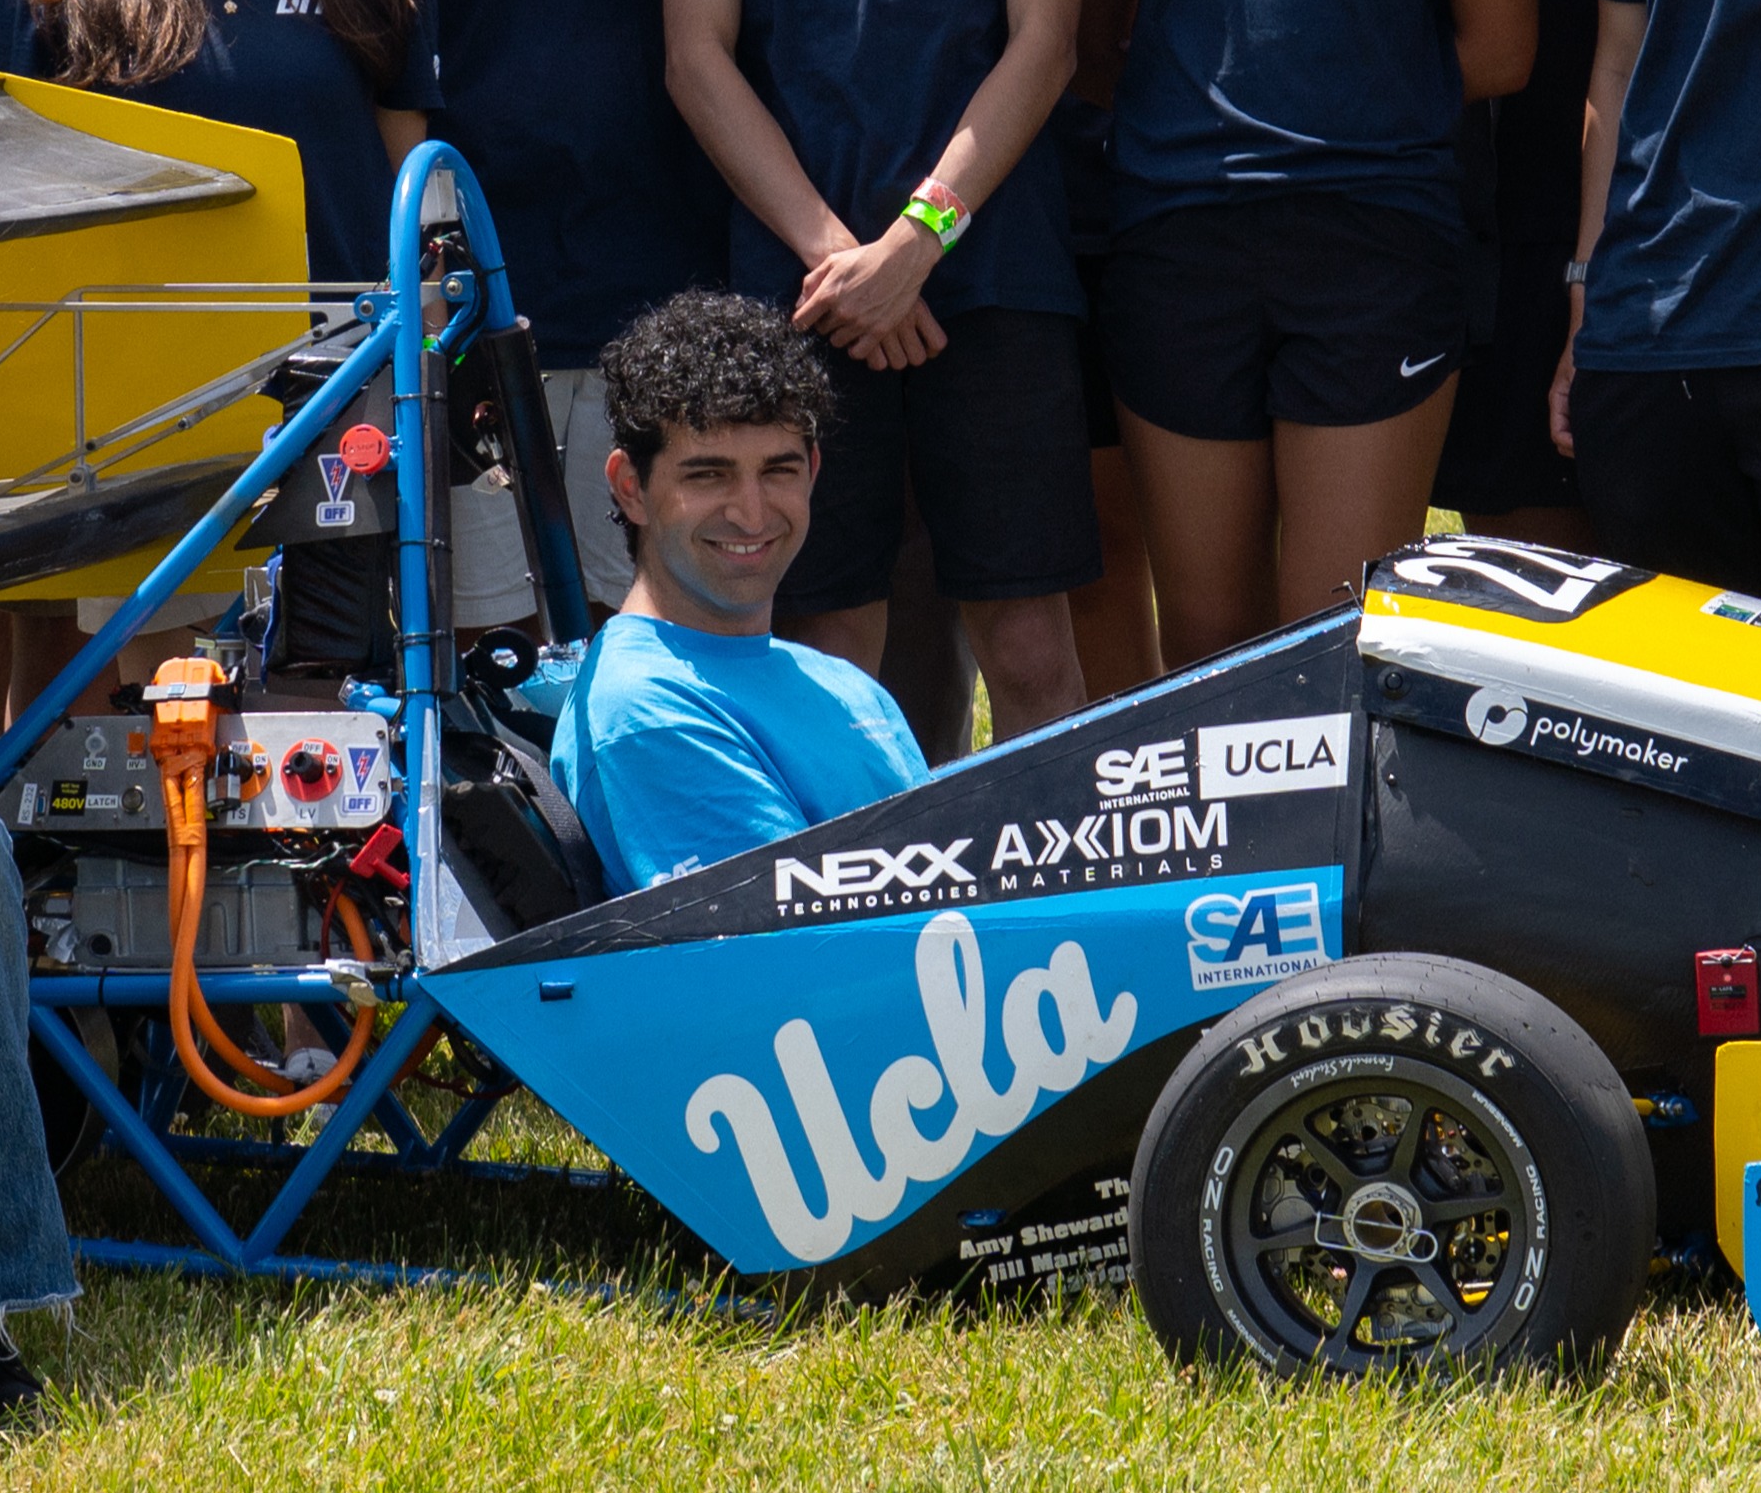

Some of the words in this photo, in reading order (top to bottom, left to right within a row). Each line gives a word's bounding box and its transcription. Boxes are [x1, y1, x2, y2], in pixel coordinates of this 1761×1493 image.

[324, 507, 347, 520] OFF
[1394, 535, 1627, 613] 22
[1095, 738, 1189, 797] SAE
[1224, 734, 1337, 777] UCLA
[1530, 714, 1689, 773] polymaker
[52, 797, 86, 810] 480V
[88, 796, 117, 807] LATCH
[299, 808, 317, 819] LV
[348, 797, 372, 809] OFF
[1099, 786, 1191, 811] INTERNATIONAL
[775, 837, 977, 901] NEXX
[1001, 853, 1223, 891] MATERIALS
[777, 884, 978, 917] TECHNOLOGIES
[1190, 887, 1320, 964] SAE
[1237, 1003, 1515, 1078] Hoosier
[685, 911, 1138, 1262] Ucla
[1525, 1164, 1546, 1240] RACING
[959, 1234, 1014, 1260] Amy
[1020, 1206, 1130, 1247] Sheward
[1202, 1217, 1224, 1294] RACING
[988, 1258, 1026, 1284] Jill
[1031, 1236, 1129, 1275] Mariani
